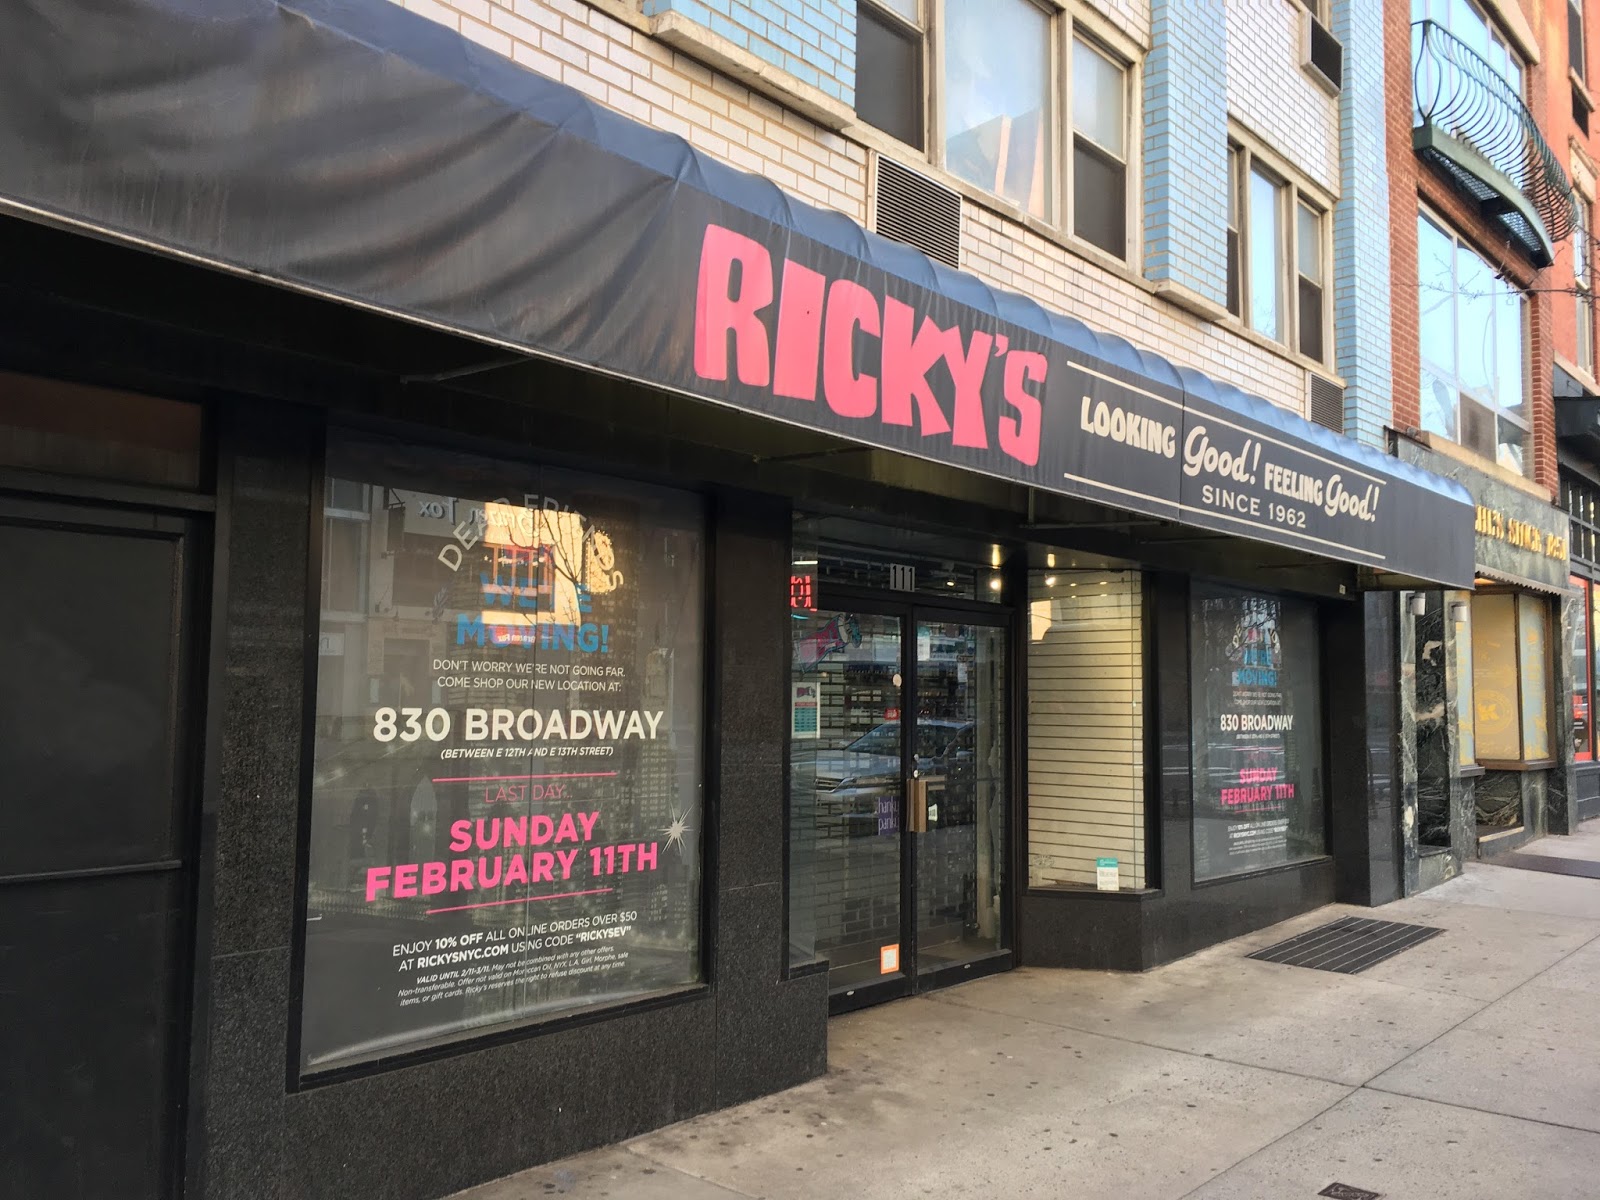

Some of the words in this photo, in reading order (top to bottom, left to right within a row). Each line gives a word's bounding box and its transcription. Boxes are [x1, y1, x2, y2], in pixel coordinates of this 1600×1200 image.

[694, 224, 1047, 466] RICKY'S
[1081, 396, 1176, 458] LOOKING
[1183, 426, 1261, 485] Good!
[1264, 462, 1323, 506] FEELING
[1324, 474, 1379, 523] Good!
[1202, 484, 1260, 516] SINCE
[1269, 503, 1306, 528] 1962
[892, 565, 914, 591] 111
[456, 613, 609, 653] MOVING!
[433, 659, 468, 671] DON'T
[471, 661, 513, 673] WORRY
[515, 663, 547, 674] WE'RE
[550, 664, 570, 675] NOT
[572, 665, 604, 677] GOING
[605, 666, 625, 677] FAR.
[437, 677, 471, 688] COME
[473, 677, 503, 689] SHOP
[506, 678, 529, 690] OUR
[531, 680, 555, 690] NEW
[557, 680, 606, 691] LOCATION
[608, 681, 622, 692] AT:
[373, 707, 451, 742] 830
[465, 708, 664, 741] BROADWAY
[1220, 714, 1239, 731] 830
[1241, 714, 1294, 731] BROADWAY
[440, 748, 495, 760] (BETWEEN
[496, 748, 503, 758] E
[504, 748, 526, 758] 12TH
[549, 748, 556, 757] E
[558, 747, 579, 757] 13TH
[579, 746, 614, 757] STREET)
[485, 785, 528, 803] LAST
[1221, 785, 1273, 805] FEBRUARY
[1275, 783, 1295, 799] 11TH
[449, 811, 600, 853] SUNDAY
[365, 849, 578, 902] FEBRUARY
[589, 842, 658, 876] 11TH
[393, 940, 433, 957] ENJOY
[435, 936, 458, 950] 10%
[460, 932, 484, 946] OFF
[485, 929, 506, 942] ALL
[550, 918, 590, 933] ORDERS
[592, 913, 618, 926] OVER
[620, 910, 638, 923] $50
[398, 959, 415, 973] AT
[417, 943, 509, 969] RICKYSNYC.COM
[511, 939, 542, 953] USNG
[544, 934, 574, 948] CODE
[416, 974, 438, 985] VALID
[439, 970, 460, 981] UNTIL
